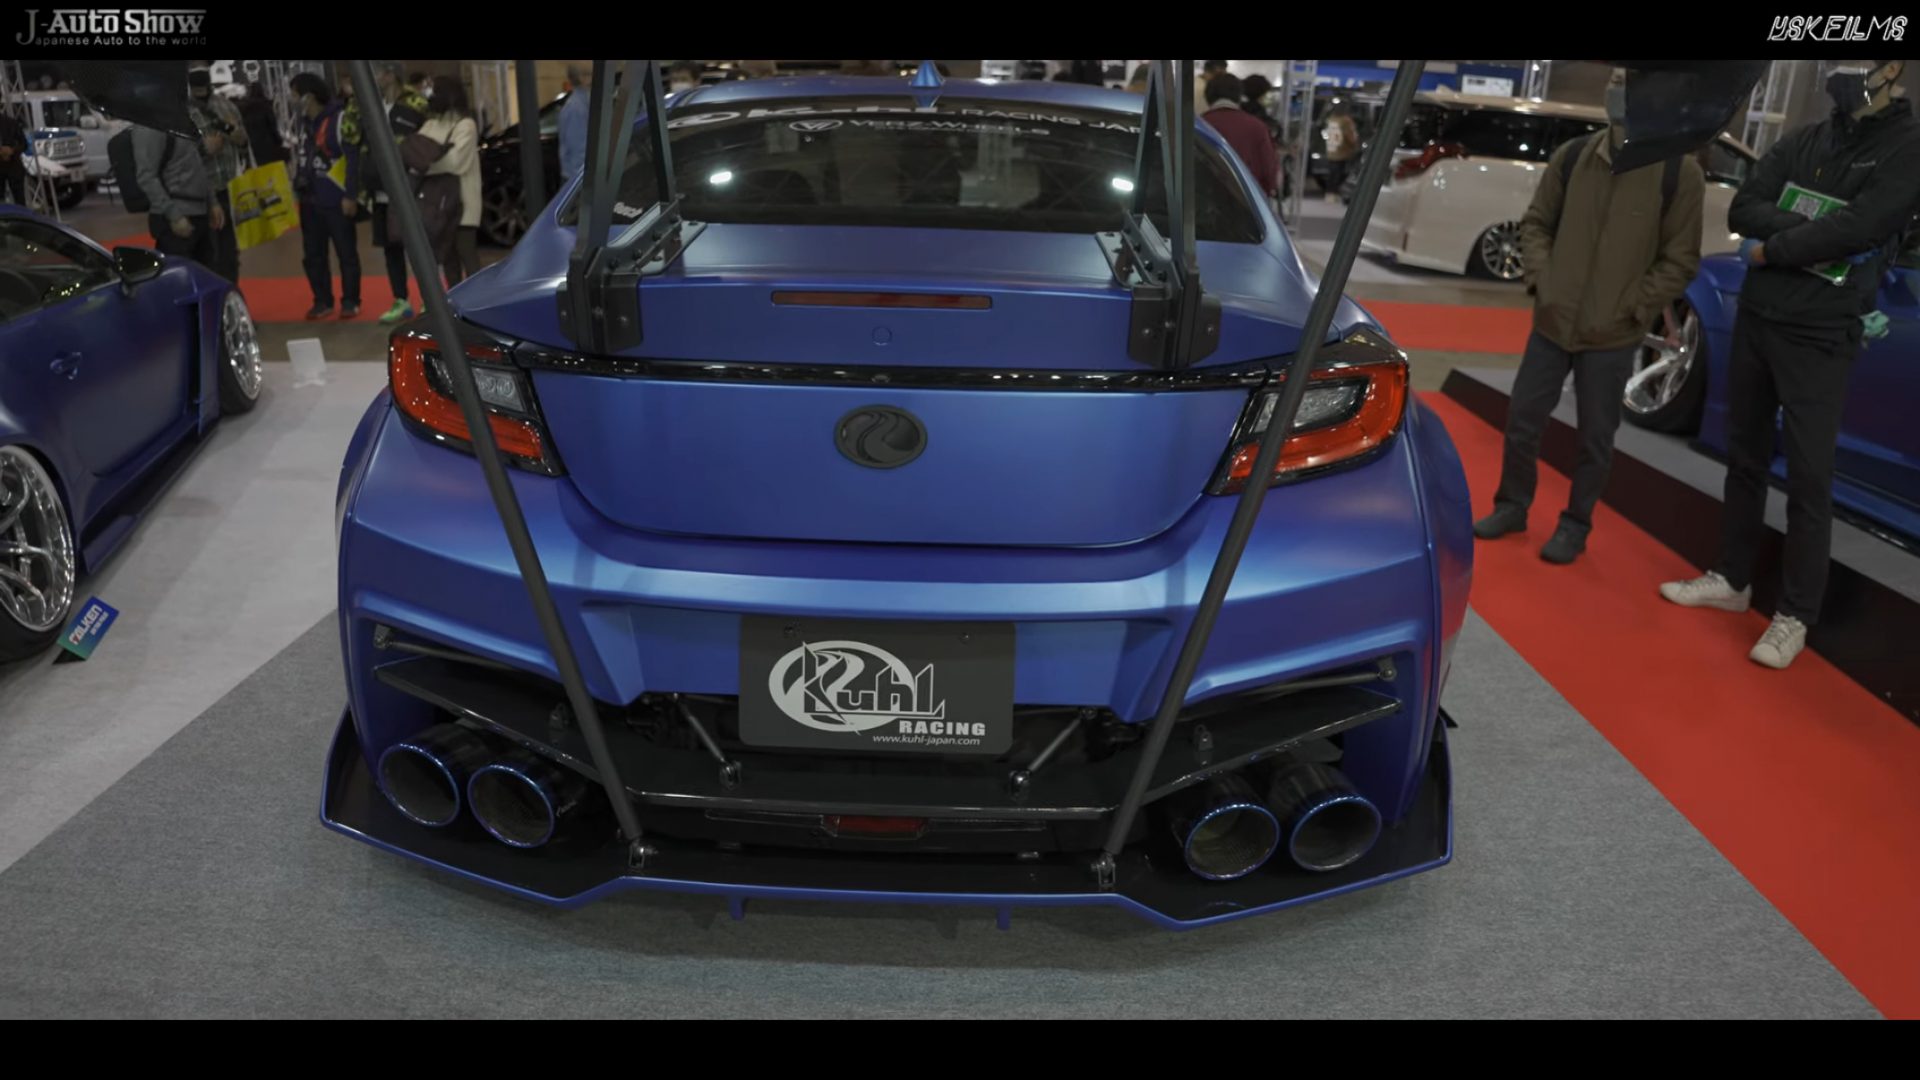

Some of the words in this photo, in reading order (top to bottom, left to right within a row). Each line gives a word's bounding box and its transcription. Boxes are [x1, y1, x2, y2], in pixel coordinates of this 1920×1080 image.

[961, 108, 1081, 126] RACING
[899, 720, 986, 736] RACING
[872, 735, 980, 746] www.kuhl-japan.com
